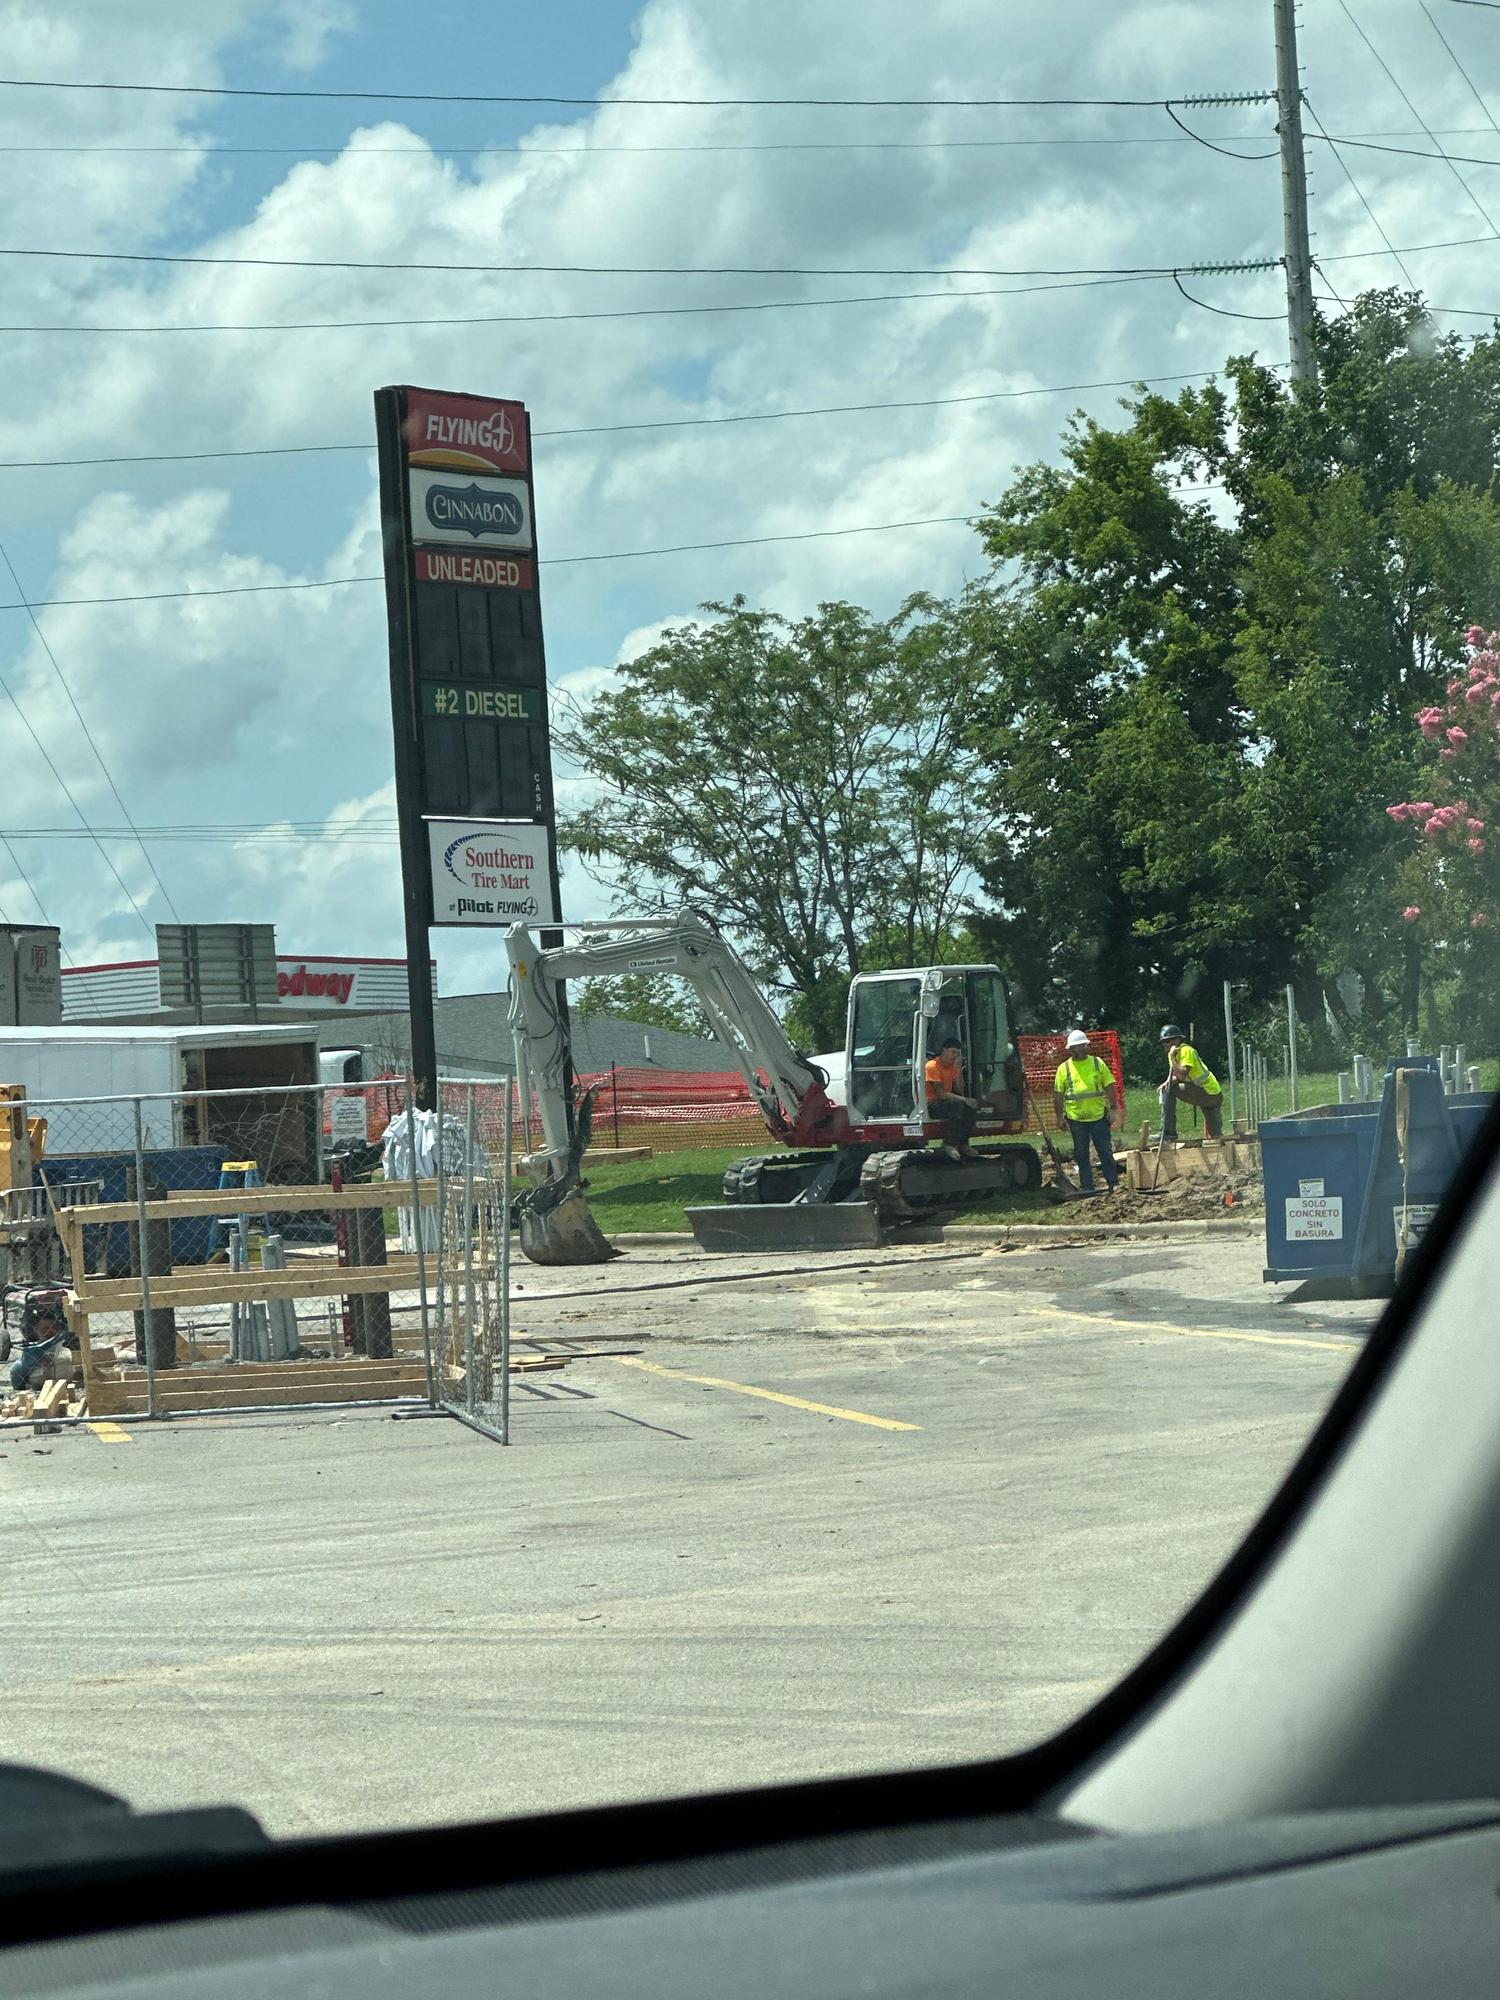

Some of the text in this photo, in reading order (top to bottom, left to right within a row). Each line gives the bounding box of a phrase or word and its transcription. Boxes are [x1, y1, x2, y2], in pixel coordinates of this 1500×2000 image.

[426, 414, 493, 448] FLYING
[432, 494, 518, 525] CINNABON
[427, 554, 519, 586] UNLEADED
[434, 687, 529, 718] #2 DIESEL
[534, 773, 542, 812] CASH
[465, 847, 535, 870] Southern
[471, 872, 530, 890] Tire Mart
[457, 898, 494, 916] Pilot
[497, 901, 526, 914] FLYING
[1289, 1209, 1340, 1218] CONCRETO
[1302, 1200, 1327, 1208] SOLO
[1295, 1230, 1335, 1238] BASURA
[1307, 1220, 1323, 1229] SIN
